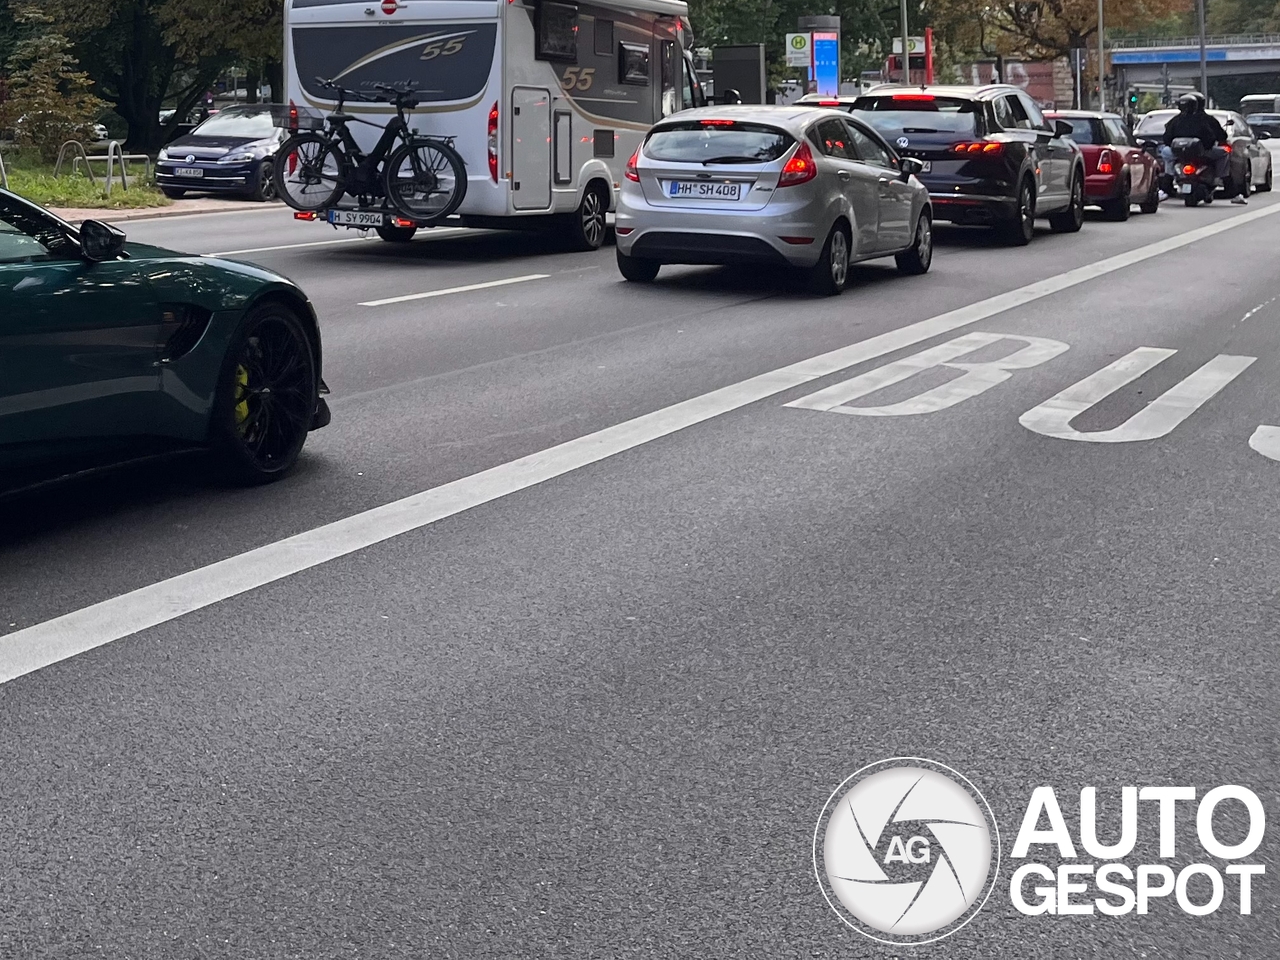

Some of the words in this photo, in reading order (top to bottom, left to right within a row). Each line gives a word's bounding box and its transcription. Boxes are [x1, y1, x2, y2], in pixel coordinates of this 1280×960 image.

[419, 36, 466, 60] 55
[562, 66, 596, 91] 55
[677, 183, 692, 194] HH
[699, 184, 714, 195] SH
[716, 185, 737, 196] 408
[334, 213, 340, 221] H
[346, 213, 358, 222] SY
[360, 214, 381, 223] 9904
[782, 331, 1280, 462] BU
